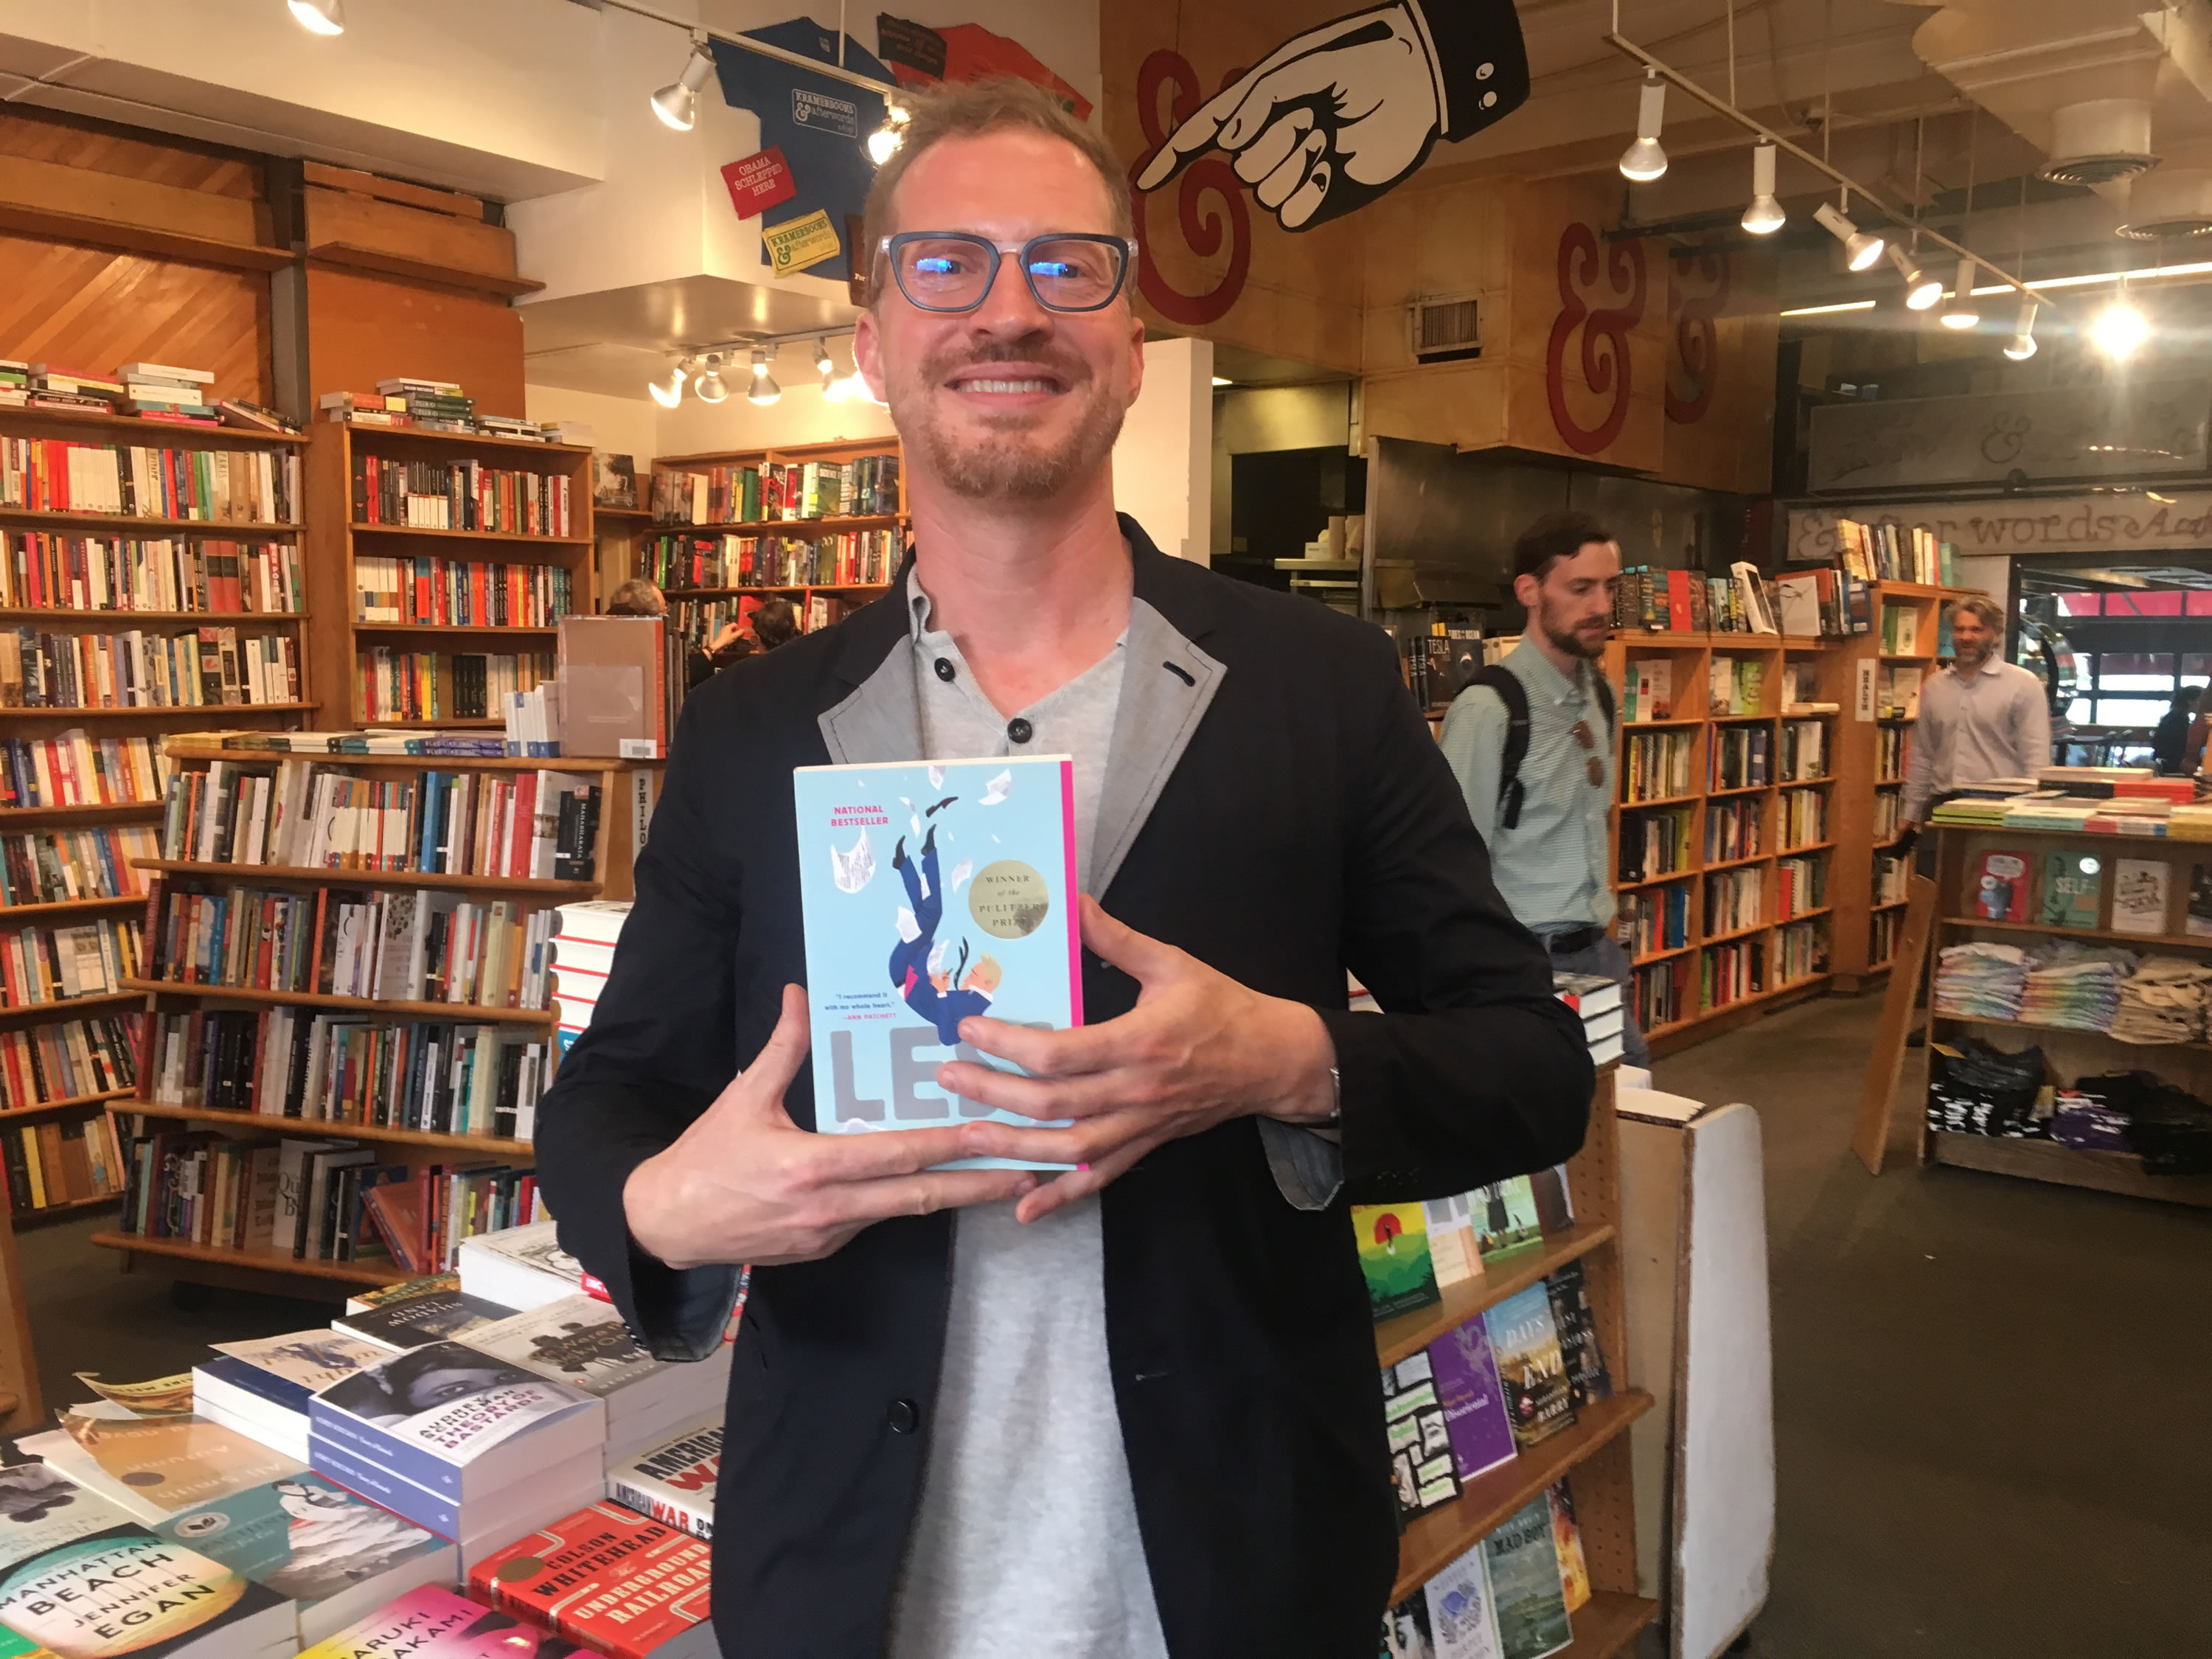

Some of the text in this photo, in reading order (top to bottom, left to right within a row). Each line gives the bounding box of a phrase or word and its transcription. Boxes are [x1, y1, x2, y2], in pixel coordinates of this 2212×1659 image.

[796, 91, 854, 114] KRAMERBOOKS
[796, 102, 810, 122] &
[734, 163, 782, 191] SCHLEPPED
[739, 156, 771, 175] OBAMA
[752, 178, 776, 197] HERE
[771, 220, 827, 247] KRAMERBOOKS
[776, 245, 791, 265] &
[219, 453, 228, 478] PARIS
[1427, 639, 1450, 655] TESLA
[1409, 654, 1417, 677] TESLA
[1417, 653, 1427, 676] TESLA
[831, 816, 888, 827] BESTSELLER
[834, 805, 884, 815] NATIONAL
[577, 802, 587, 859] MAHABHARATA
[986, 874, 1030, 883] WINNER
[978, 902, 1040, 914] PULITZER
[419, 1397, 482, 1437] AUDREY
[434, 1389, 536, 1443] THEORY OF
[444, 1395, 543, 1449] BASTARDS
[125, 1444, 230, 1472] Autumn
[633, 1427, 726, 1481] AMERICA
[246, 1462, 281, 1476] Ali
[157, 1475, 240, 1500] Smith
[650, 1497, 690, 1532] WAR
[531, 1526, 667, 1596] WHITEHEAD
[545, 1532, 618, 1571] COLSON
[0, 1539, 164, 1610] MANHATTAN
[26, 1553, 175, 1616] BEACH
[572, 1543, 711, 1619] UNDERGROUND
[74, 1573, 197, 1628] JENNIFER
[94, 1585, 216, 1640] EGAN
[341, 1611, 431, 1659] ARUKI
[380, 1609, 473, 1659] AKAMI
